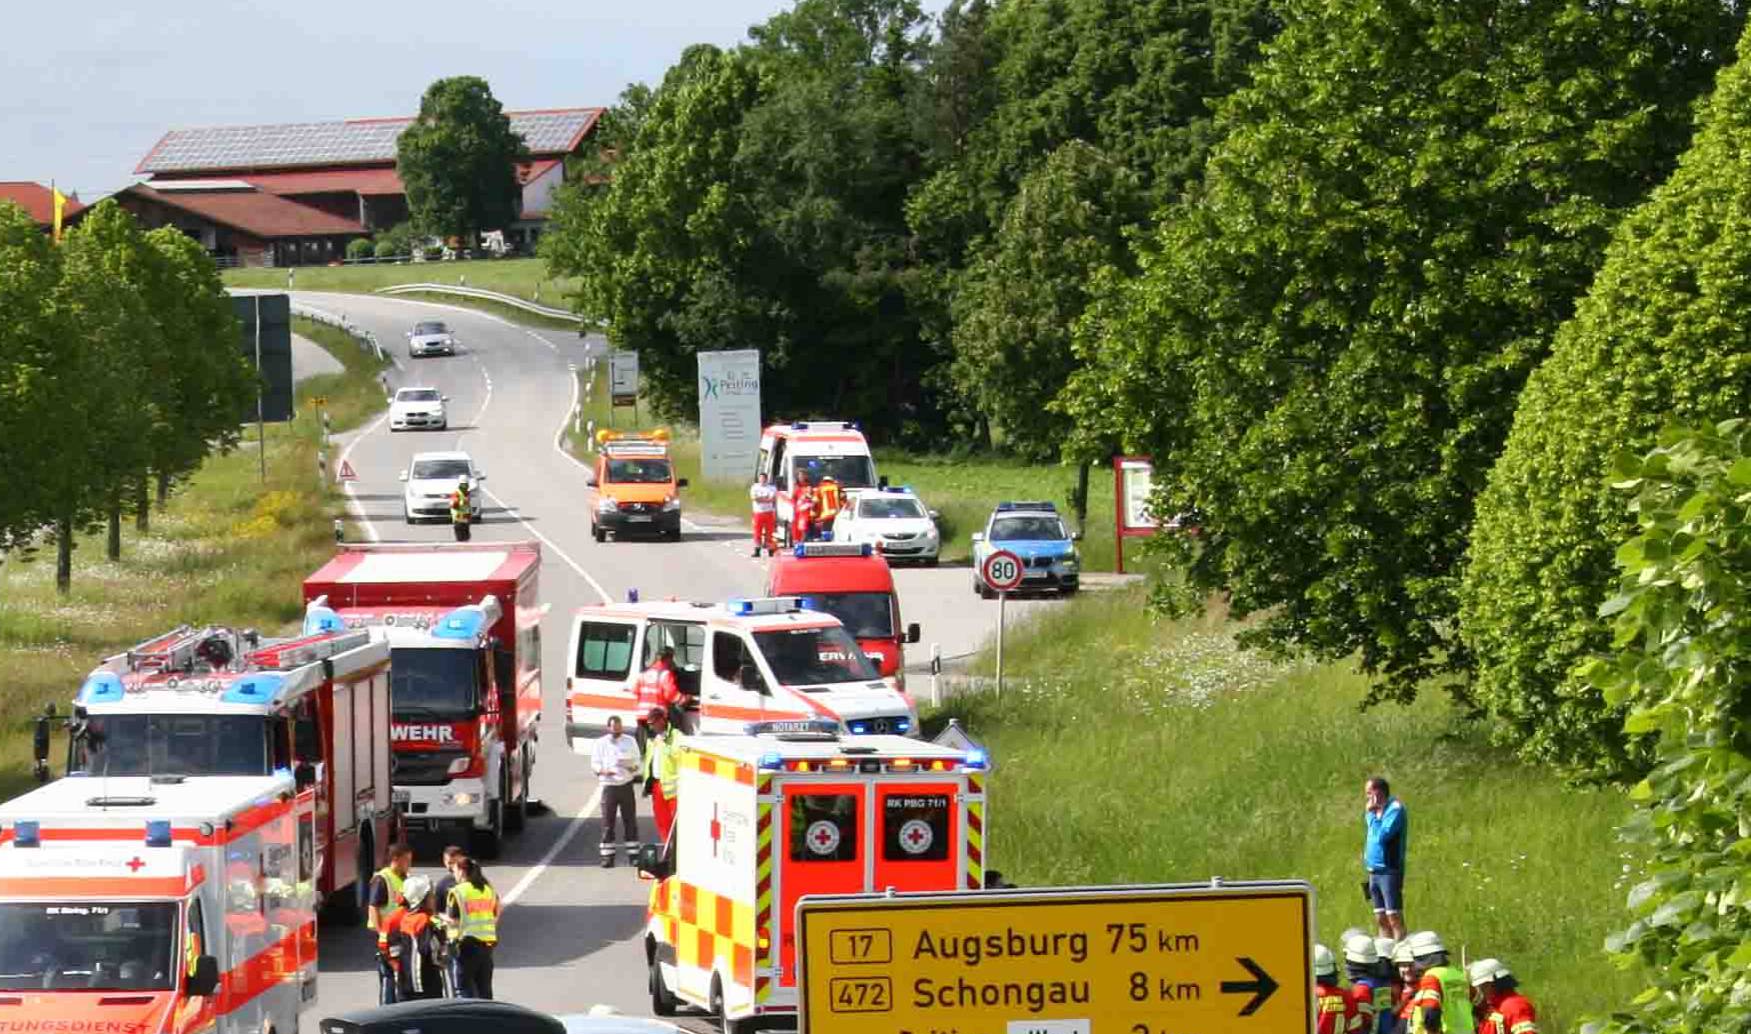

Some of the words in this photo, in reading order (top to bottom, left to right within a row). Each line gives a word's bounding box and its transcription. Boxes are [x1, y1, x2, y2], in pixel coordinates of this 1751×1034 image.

[992, 561, 1015, 580] 80
[391, 725, 453, 743] WEHR
[848, 935, 874, 959] 17
[913, 928, 1089, 967] Augsburg
[1106, 923, 1148, 954] 75
[1158, 930, 1199, 953] km
[838, 983, 885, 1007] 472
[913, 978, 1090, 1012] Schongau
[1129, 971, 1149, 1002] 8
[1159, 978, 1200, 1002] km
